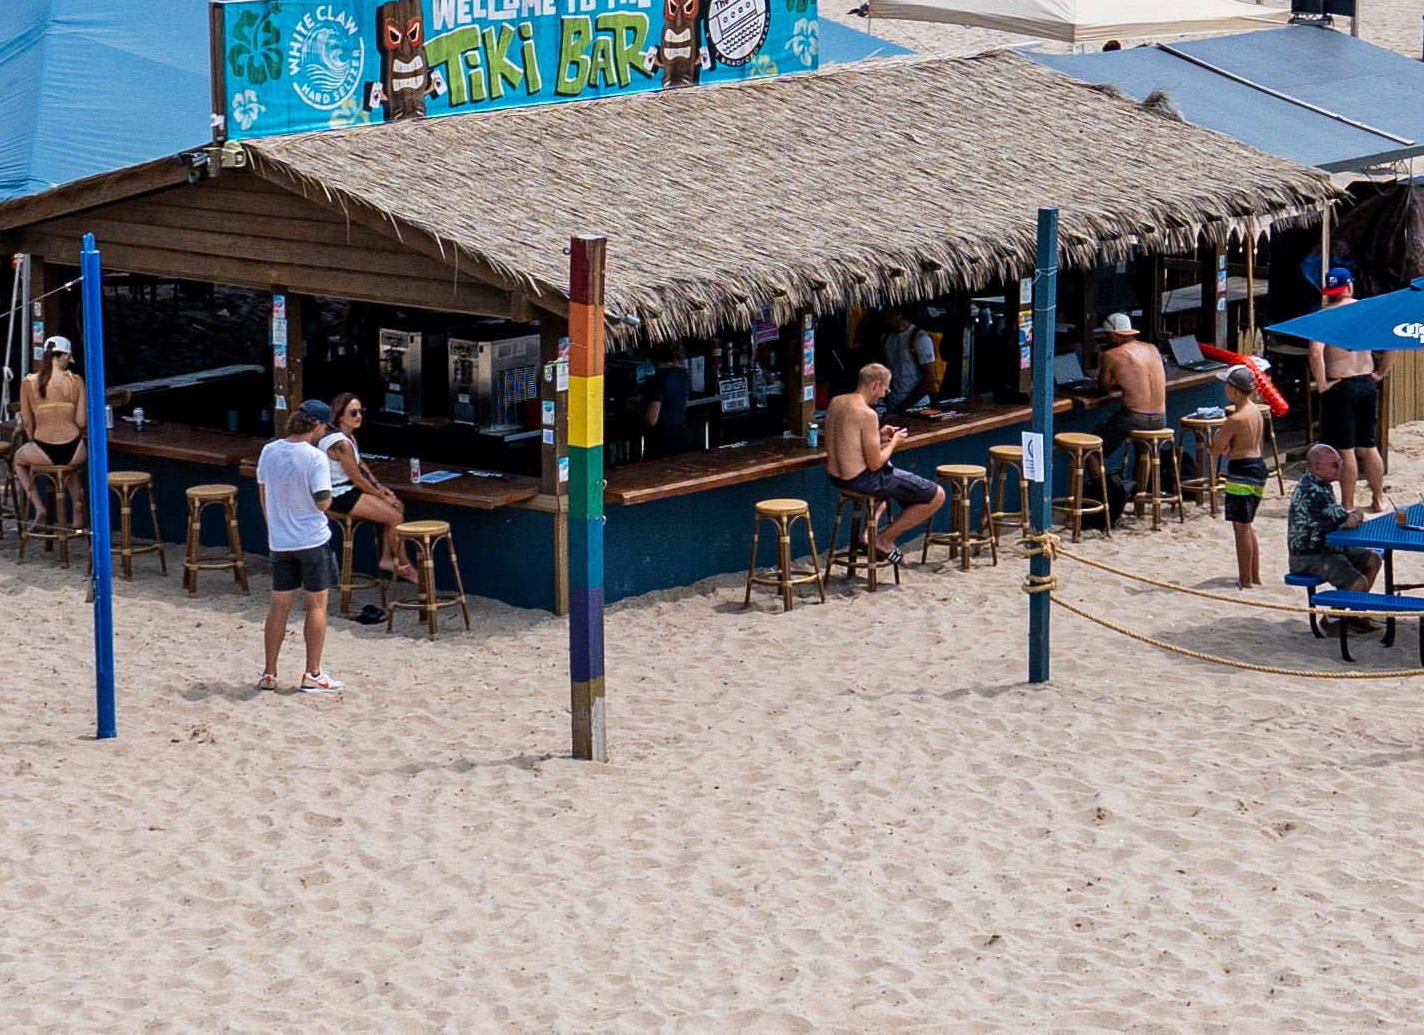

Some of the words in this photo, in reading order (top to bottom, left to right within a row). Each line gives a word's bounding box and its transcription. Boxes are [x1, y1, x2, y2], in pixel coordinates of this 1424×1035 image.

[288, 12, 316, 76] WHITE
[316, 5, 358, 36] CLAW
[301, 83, 330, 104] HARD
[333, 48, 361, 101] SELTZER
